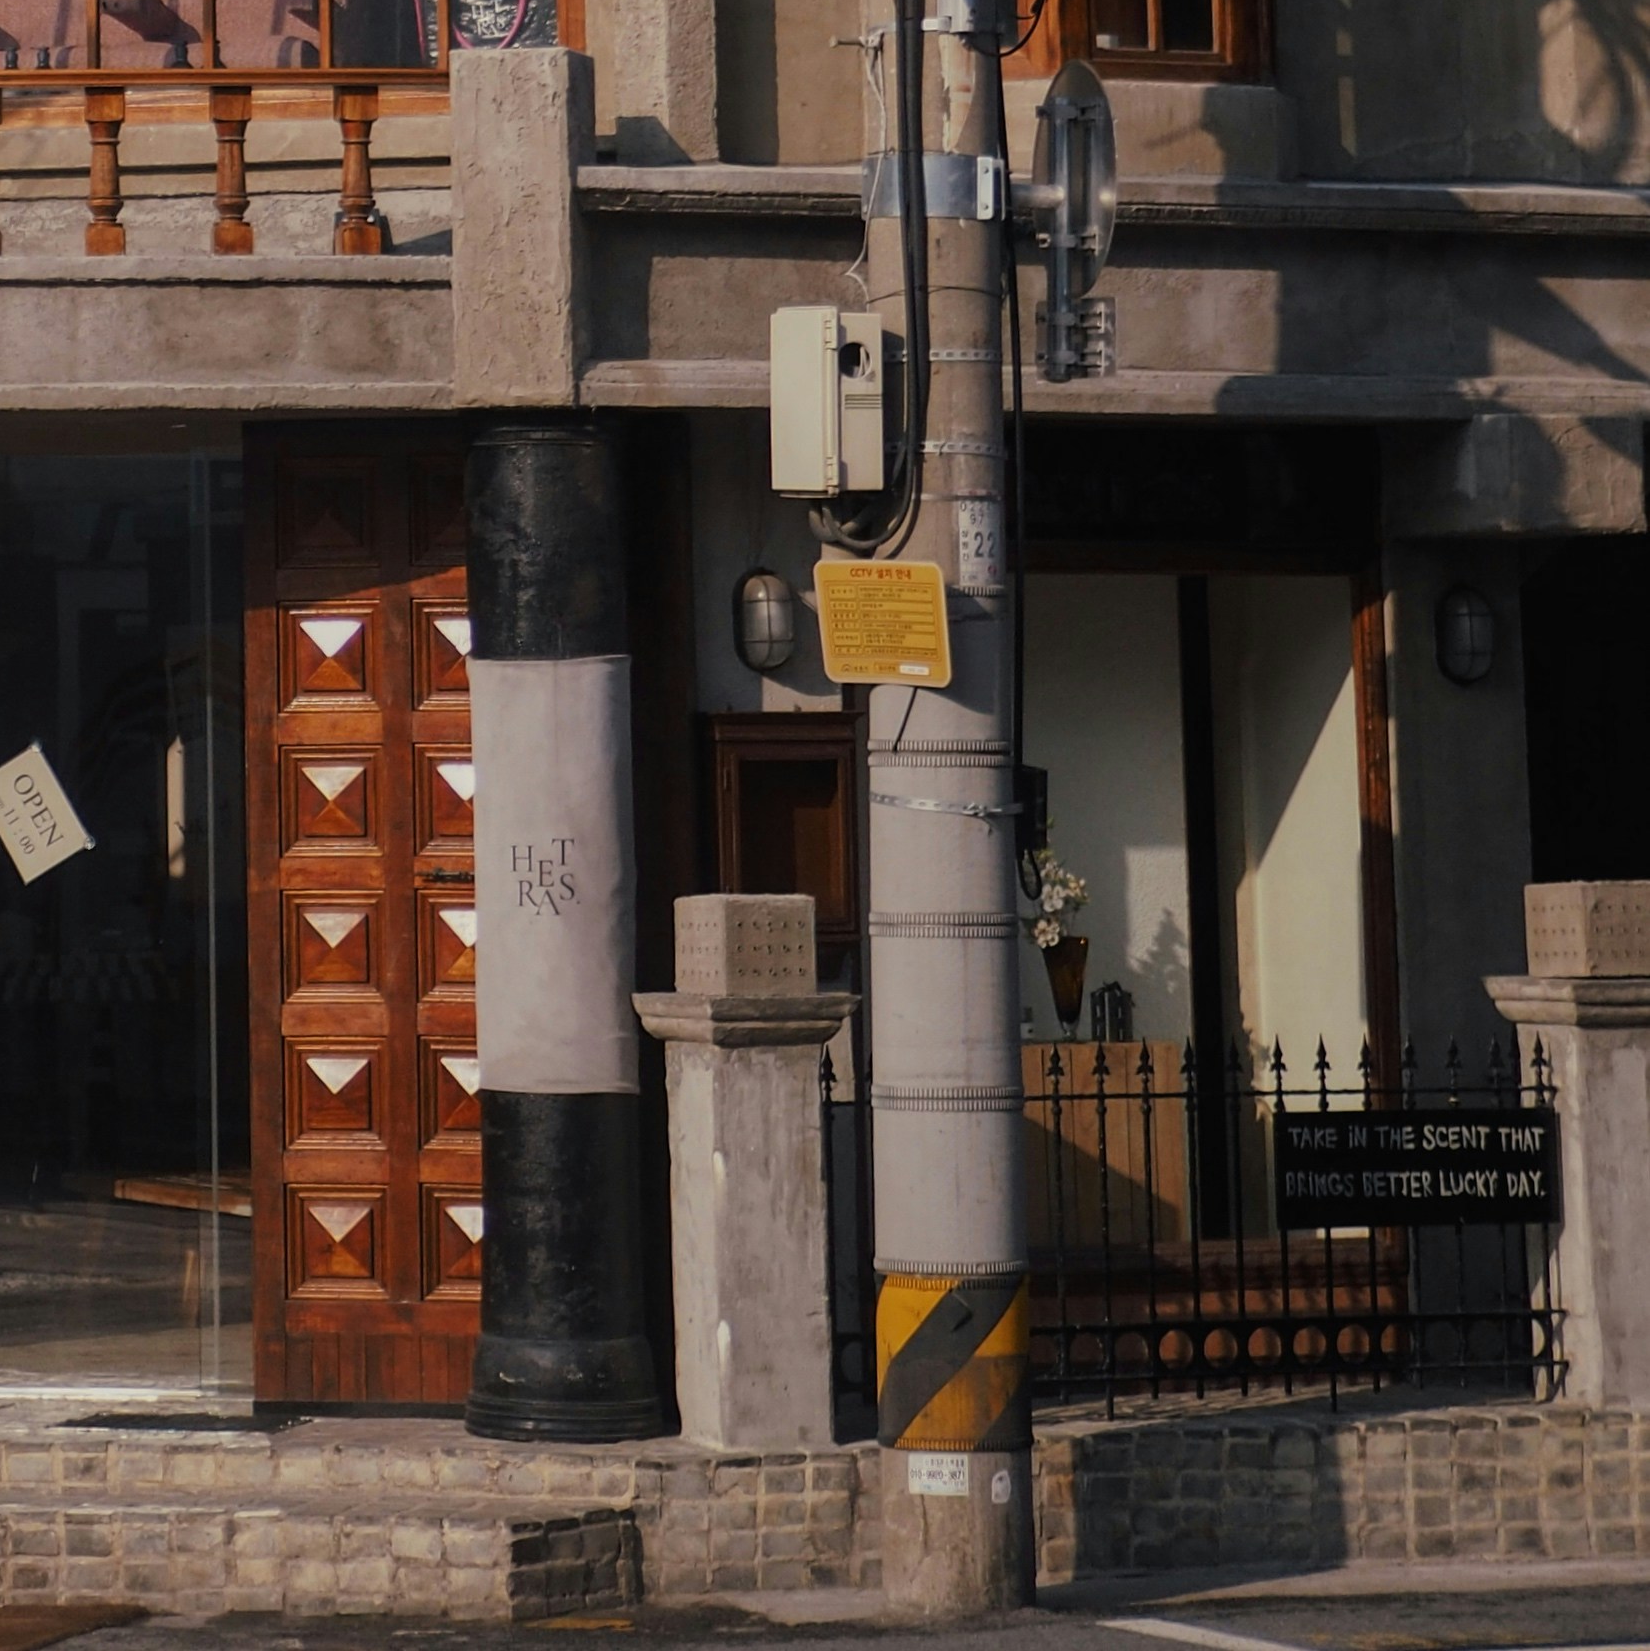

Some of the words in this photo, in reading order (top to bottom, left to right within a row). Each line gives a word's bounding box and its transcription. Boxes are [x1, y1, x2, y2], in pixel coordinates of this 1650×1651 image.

[850, 568, 872, 579] CCTV
[13, 773, 64, 849] OPEN
[1288, 1127, 1338, 1150] TAKE
[1374, 1125, 1416, 1151] THE
[1422, 1124, 1491, 1151] SCENT
[1497, 1126, 1545, 1155] THAT
[1363, 1171, 1432, 1198] BETTER
[1439, 1170, 1498, 1198] LUCKY
[1506, 1170, 1546, 1198] DAY.
